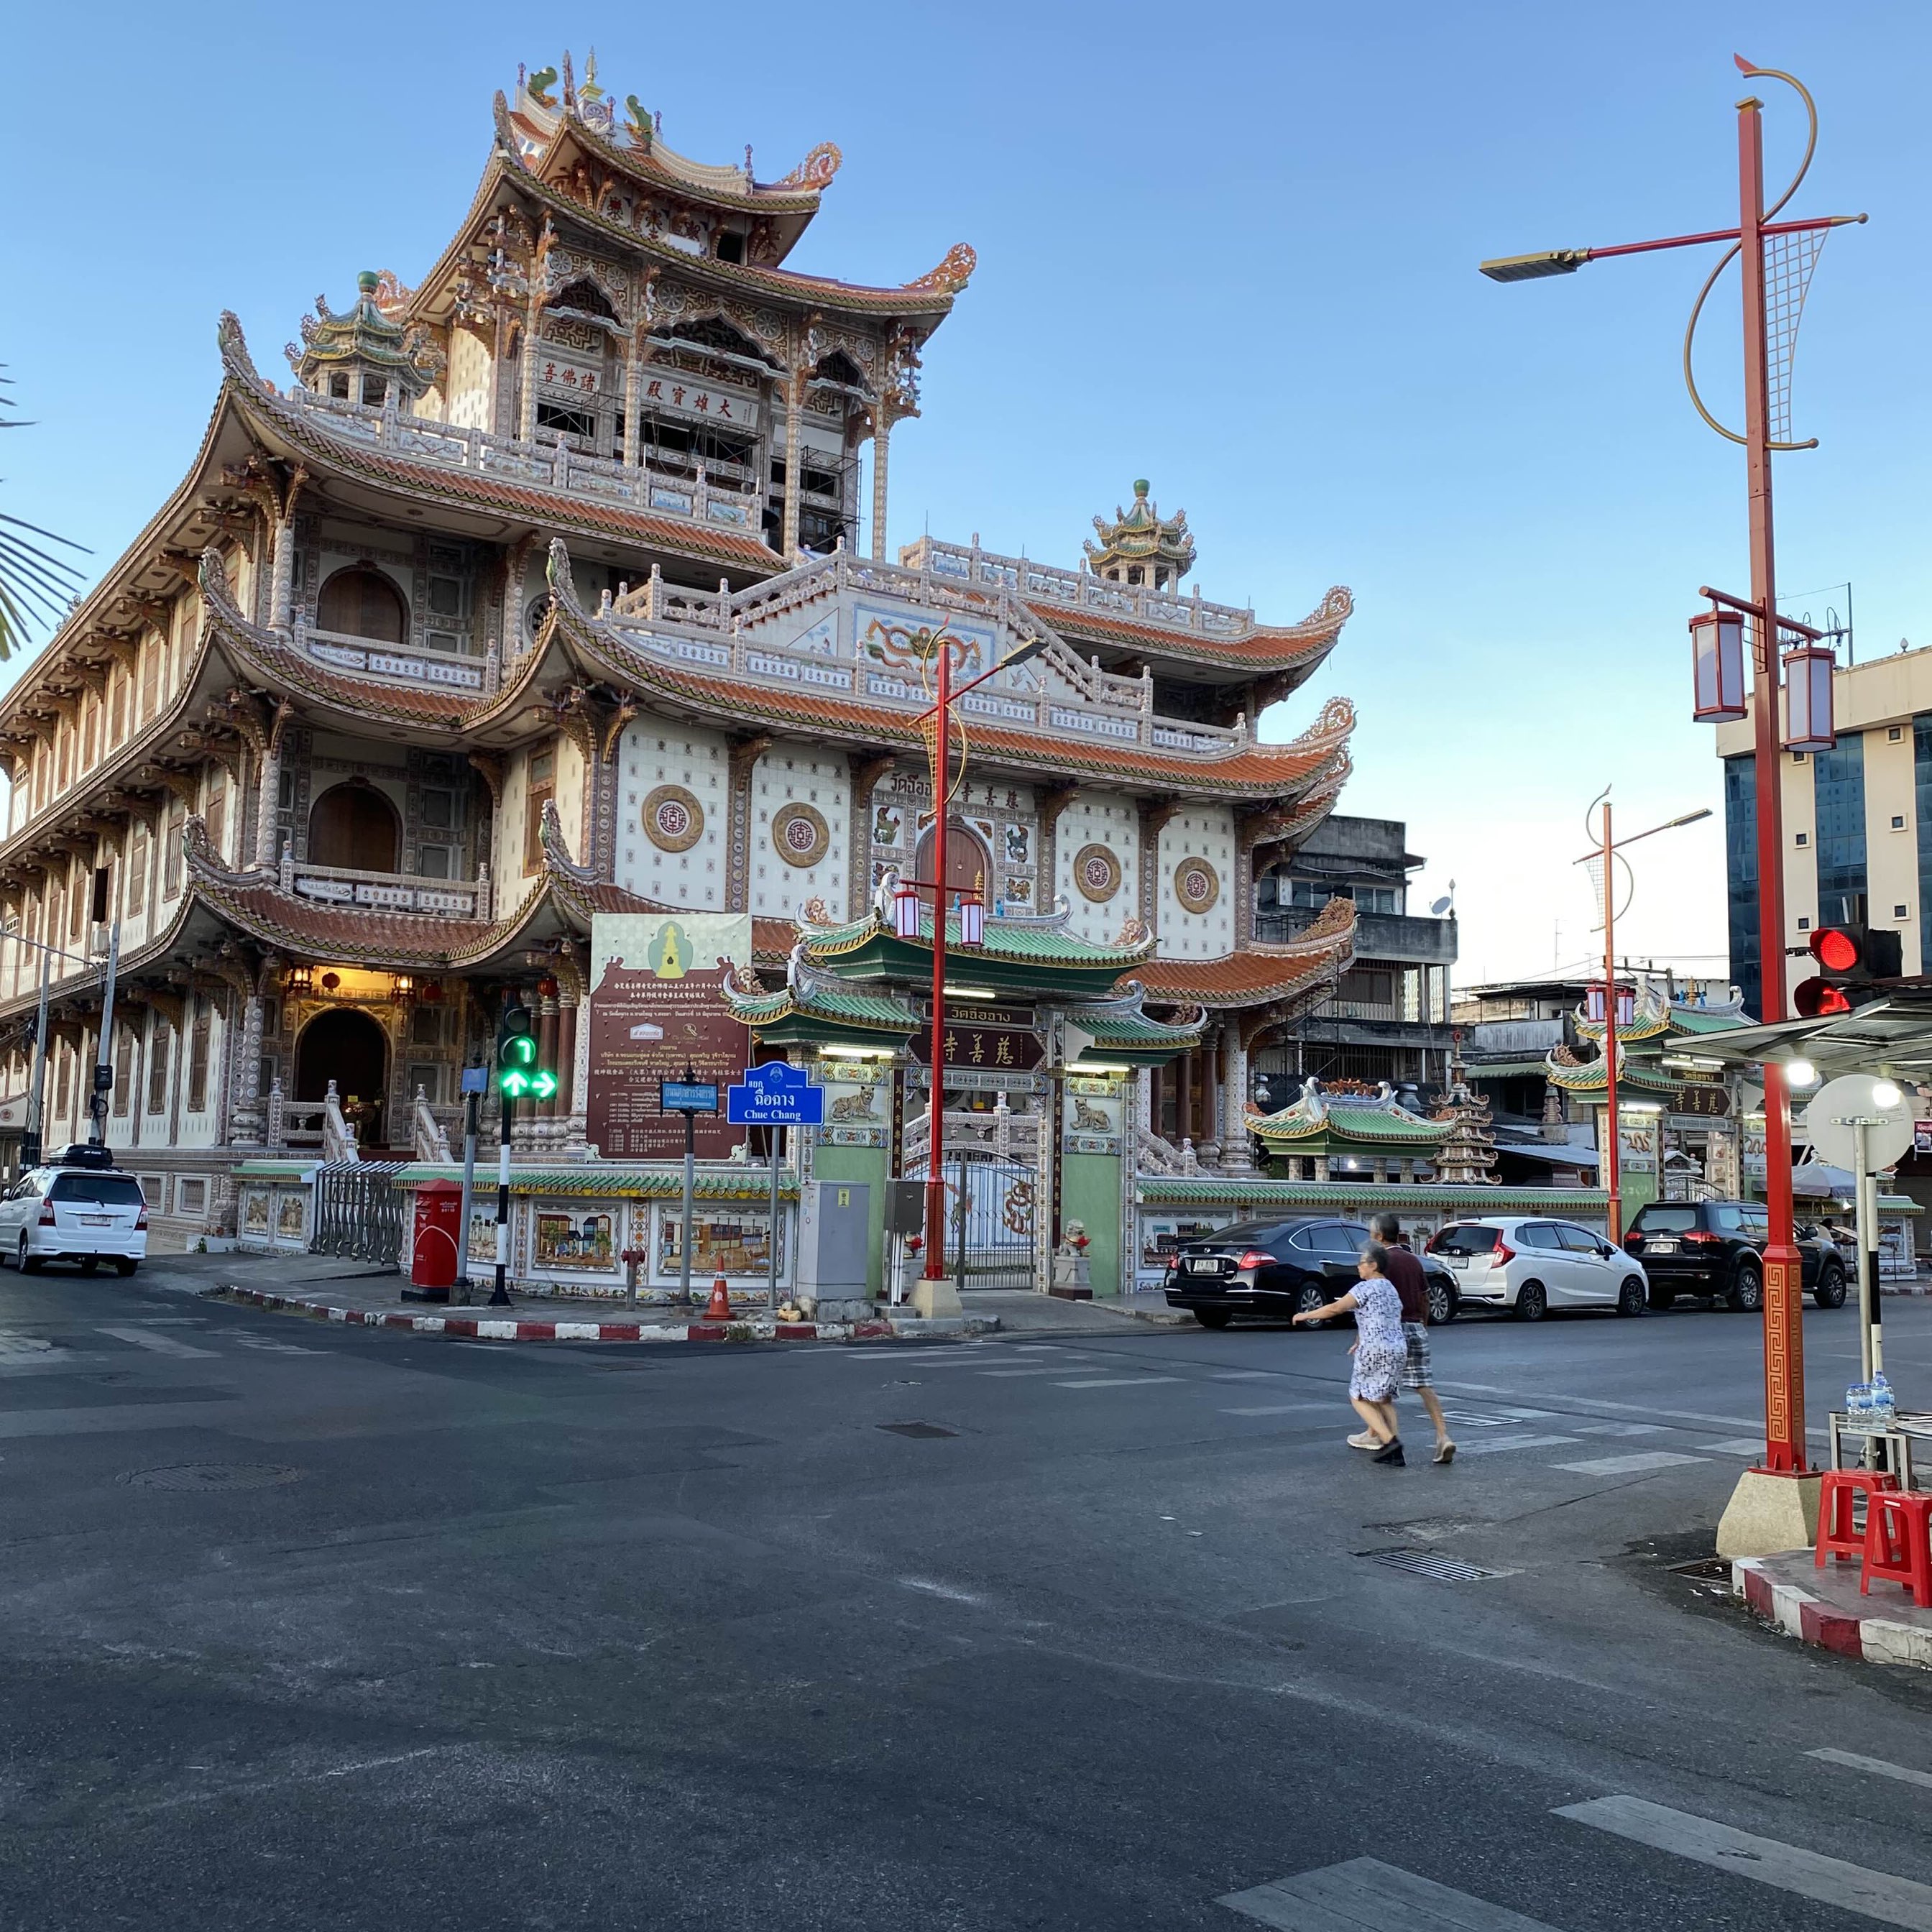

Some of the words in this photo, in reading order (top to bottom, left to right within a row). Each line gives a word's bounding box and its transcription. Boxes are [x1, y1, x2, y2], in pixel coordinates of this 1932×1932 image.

[645, 380, 732, 418] 大雄寶殿
[943, 1030, 1013, 1064] 慈善寺
[744, 1109, 768, 1119] Chue
[770, 1109, 801, 1122] Chang
